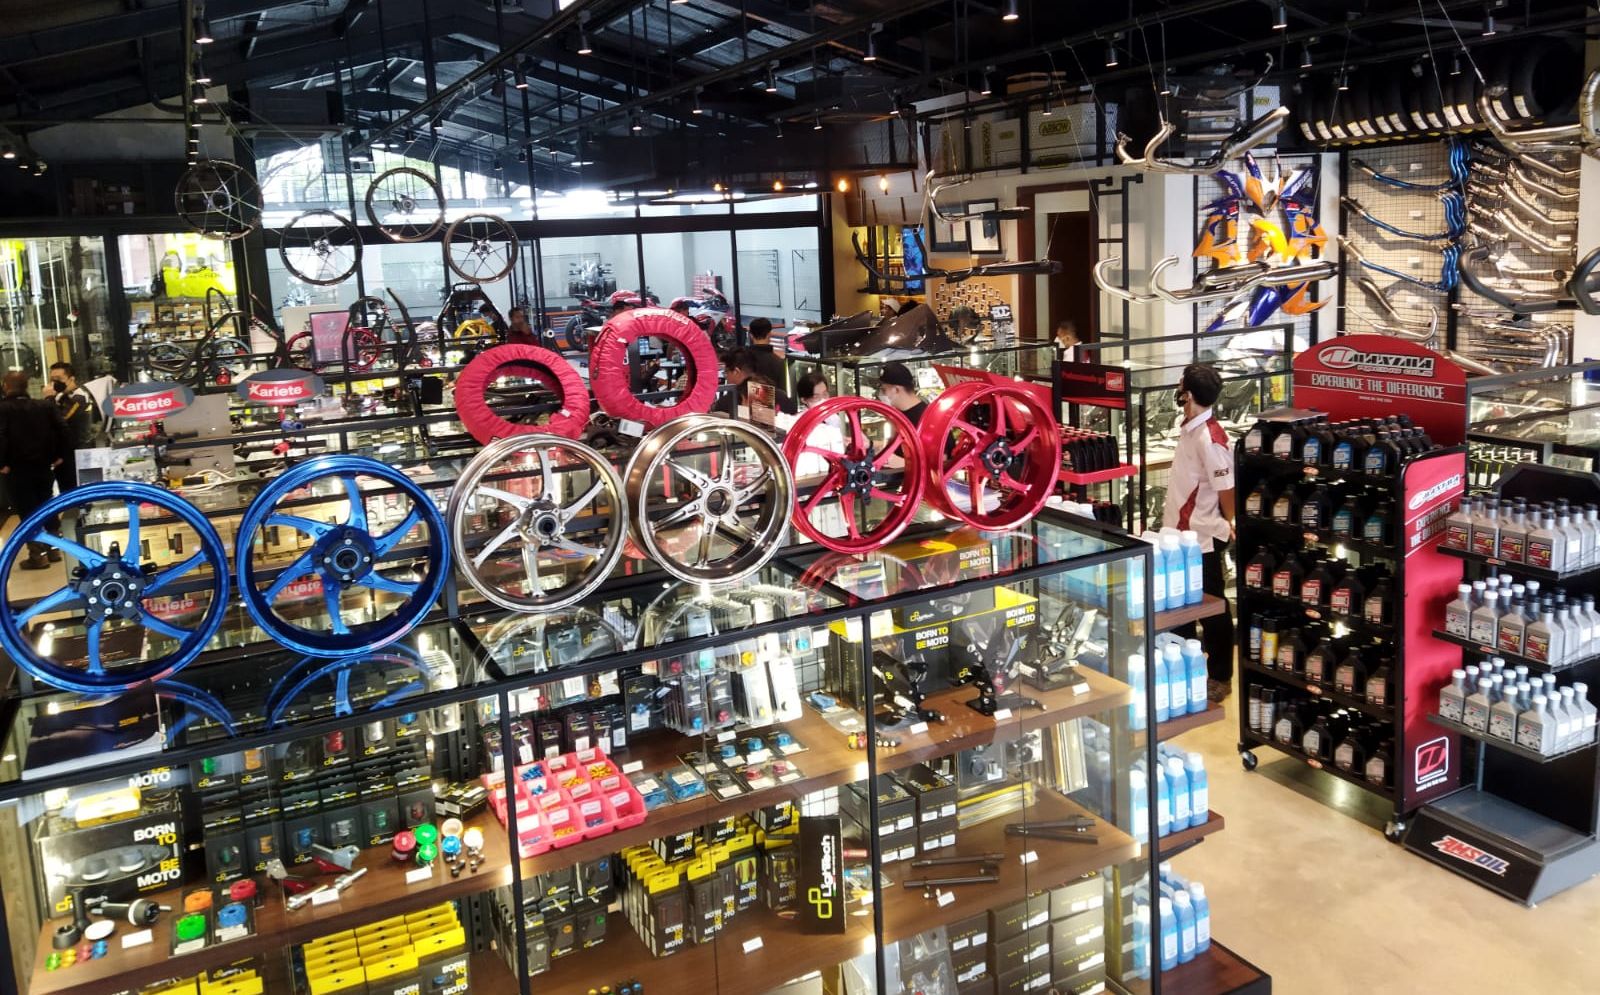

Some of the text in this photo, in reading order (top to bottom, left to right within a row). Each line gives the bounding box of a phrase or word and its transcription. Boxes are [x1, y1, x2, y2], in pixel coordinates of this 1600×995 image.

[1311, 373, 1364, 390] EXPERIENCE
[1367, 379, 1384, 393] THE
[1387, 381, 1444, 399] DIFFERENCE
[981, 547, 991, 556] TO
[1006, 604, 1035, 618] BORN TO
[1016, 613, 1035, 624] MOTO
[915, 626, 949, 641] BORN TO
[916, 635, 949, 649] BE MOTO
[128, 771, 171, 788] MOTO
[134, 822, 176, 841] BORN
[156, 833, 177, 846] TO
[1433, 836, 1509, 875] AMSOIL
[160, 858, 180, 872] BE
[137, 868, 180, 887] MOTO
[442, 959, 467, 973] BORN
[442, 982, 468, 995] MOTO
